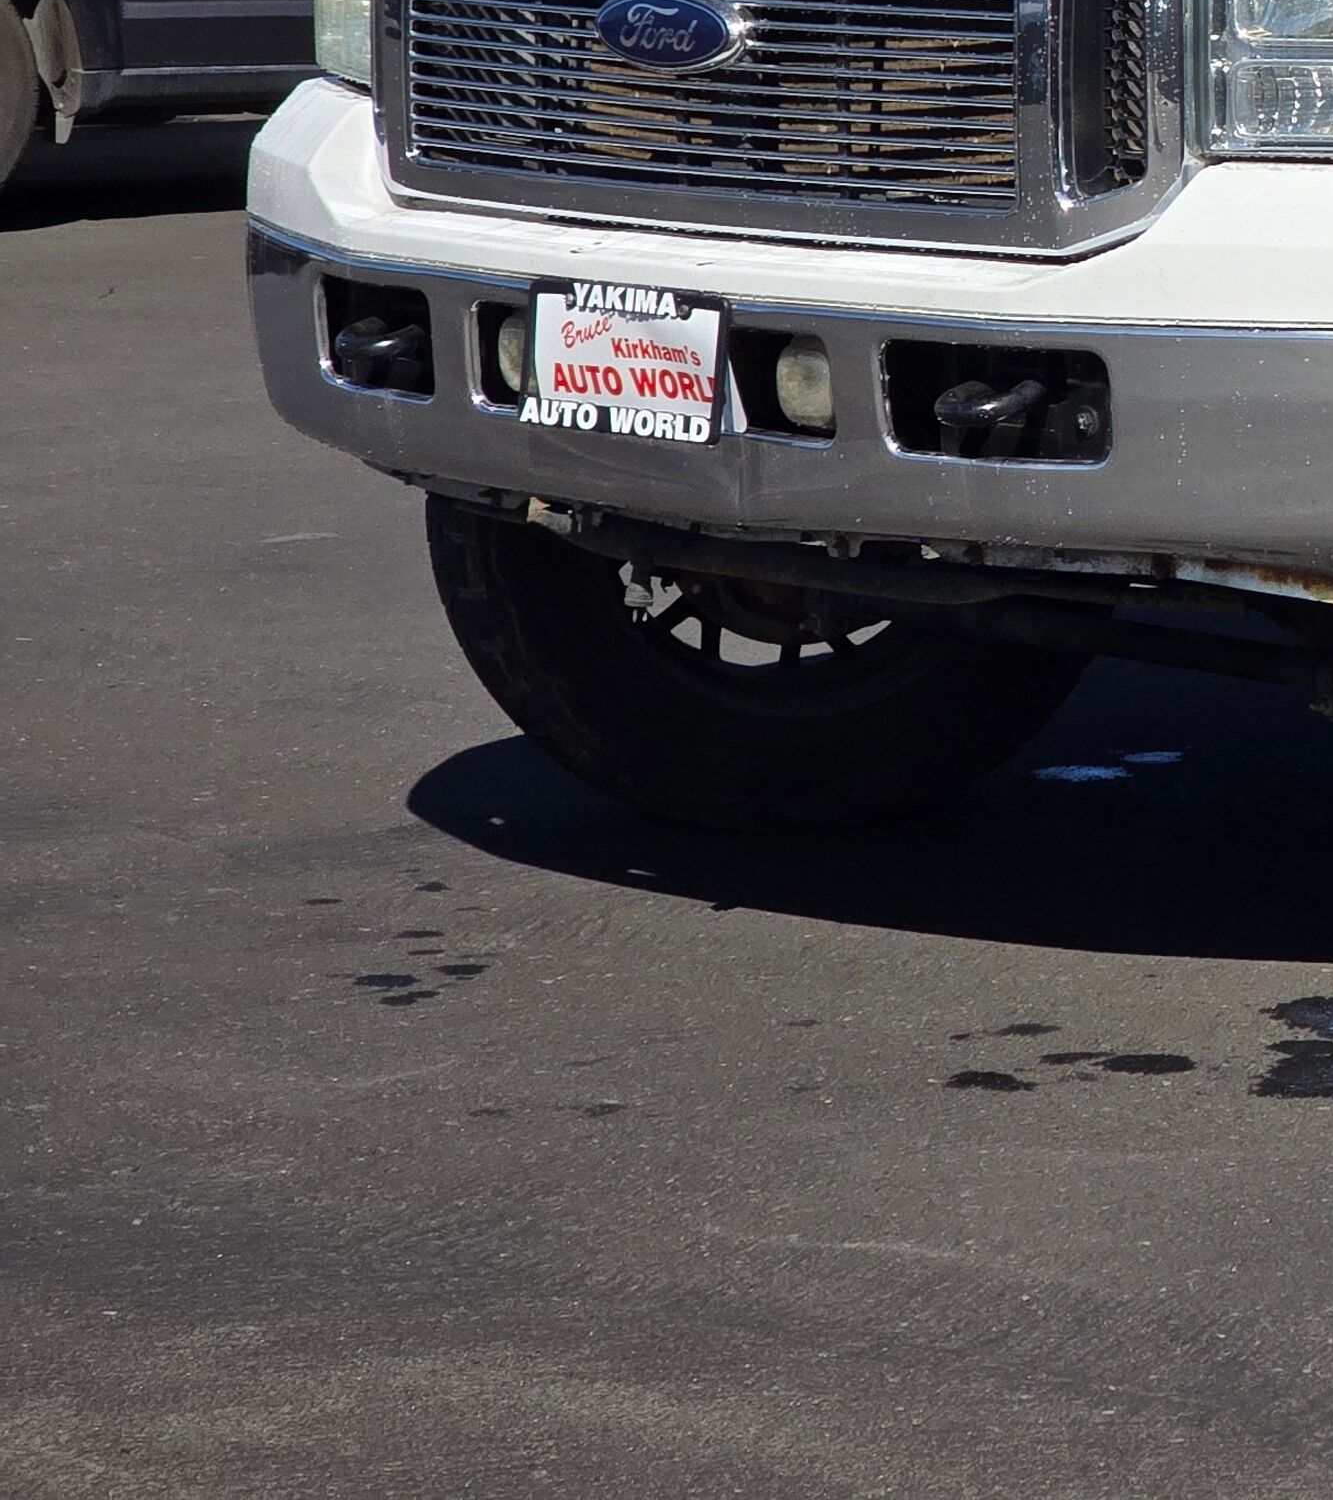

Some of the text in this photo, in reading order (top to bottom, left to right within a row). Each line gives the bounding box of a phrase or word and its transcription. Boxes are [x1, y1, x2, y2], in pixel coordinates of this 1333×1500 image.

[619, 3, 699, 52] Ford
[574, 282, 677, 318] YAKIMA
[561, 315, 613, 349] Bruce
[611, 336, 701, 367] Kirkham's
[554, 362, 624, 396] AUTO
[519, 396, 711, 444] AUTO WORLD
